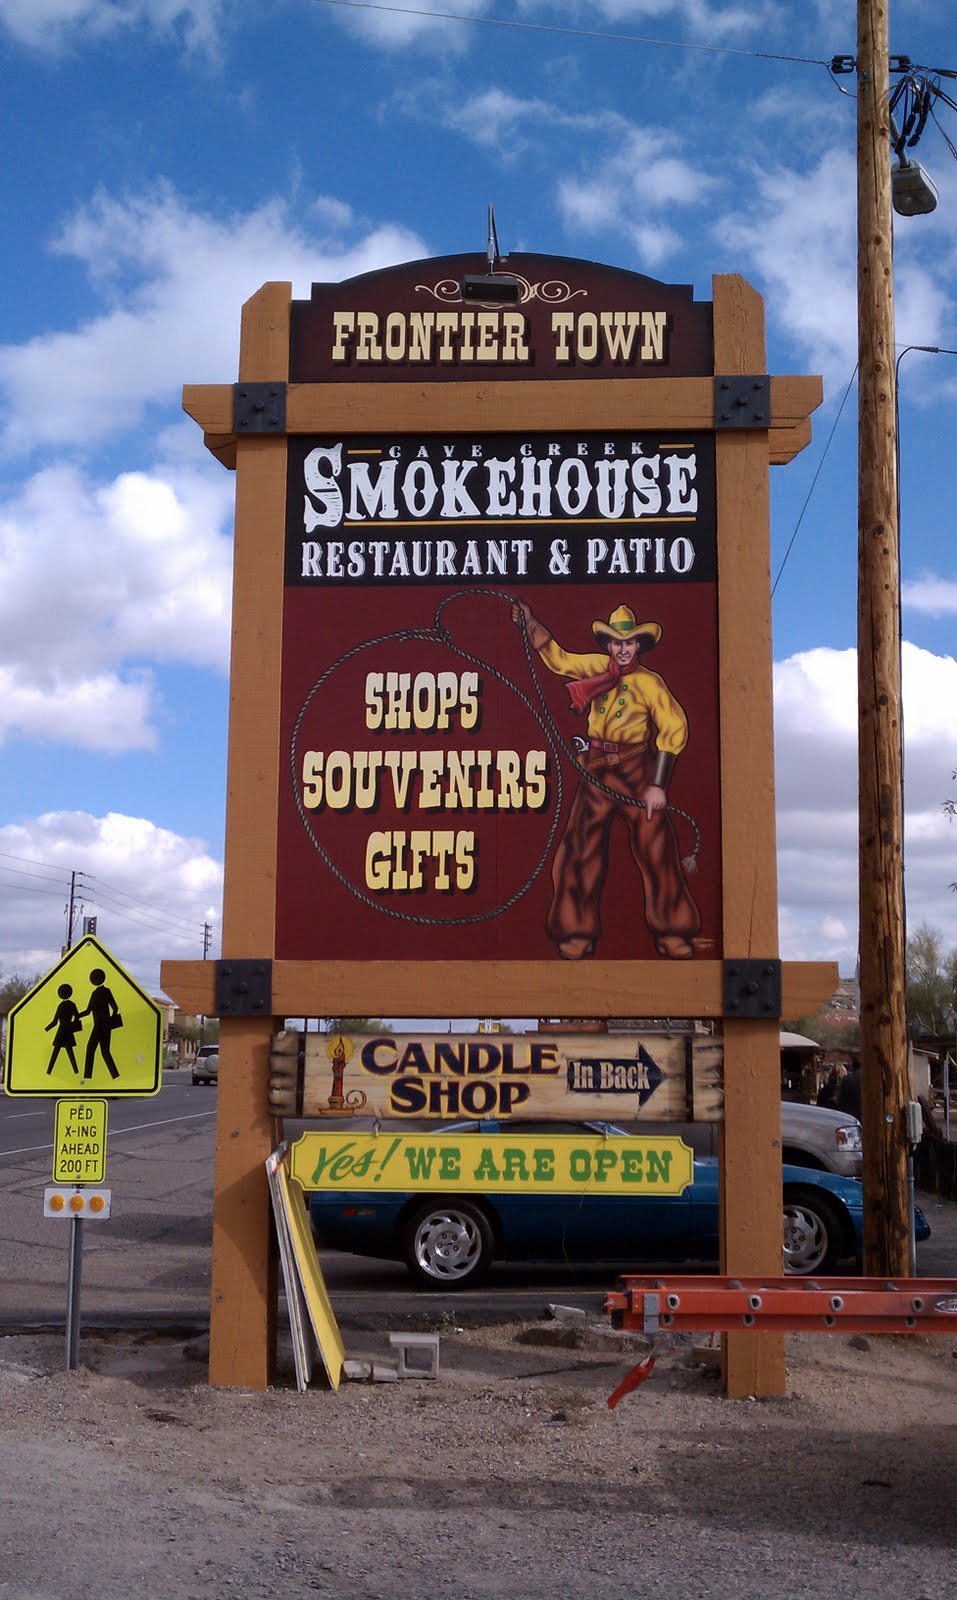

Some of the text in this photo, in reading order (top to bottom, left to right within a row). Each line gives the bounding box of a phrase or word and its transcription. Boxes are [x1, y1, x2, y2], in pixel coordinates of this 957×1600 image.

[331, 311, 668, 361] FRONTIER TOWN
[388, 442, 645, 458] CAVE CREEK
[303, 442, 699, 533] SMOKEHOUSE
[301, 536, 696, 577] RESTAURANT & PATIO
[365, 671, 480, 730] SHOPS
[302, 750, 548, 810] SOUVENIRS
[364, 830, 475, 891] GIFTS
[360, 1039, 561, 1076] CANDLE
[572, 1061, 651, 1089] In Back
[69, 1108, 93, 1120] PED
[390, 1077, 531, 1114] SHOP
[60, 1143, 100, 1155] AHEAD
[65, 1126, 97, 1138] X-ING
[60, 1160, 99, 1173] 200 FT
[311, 1138, 673, 1185] Yes! WE ARE OPEN
